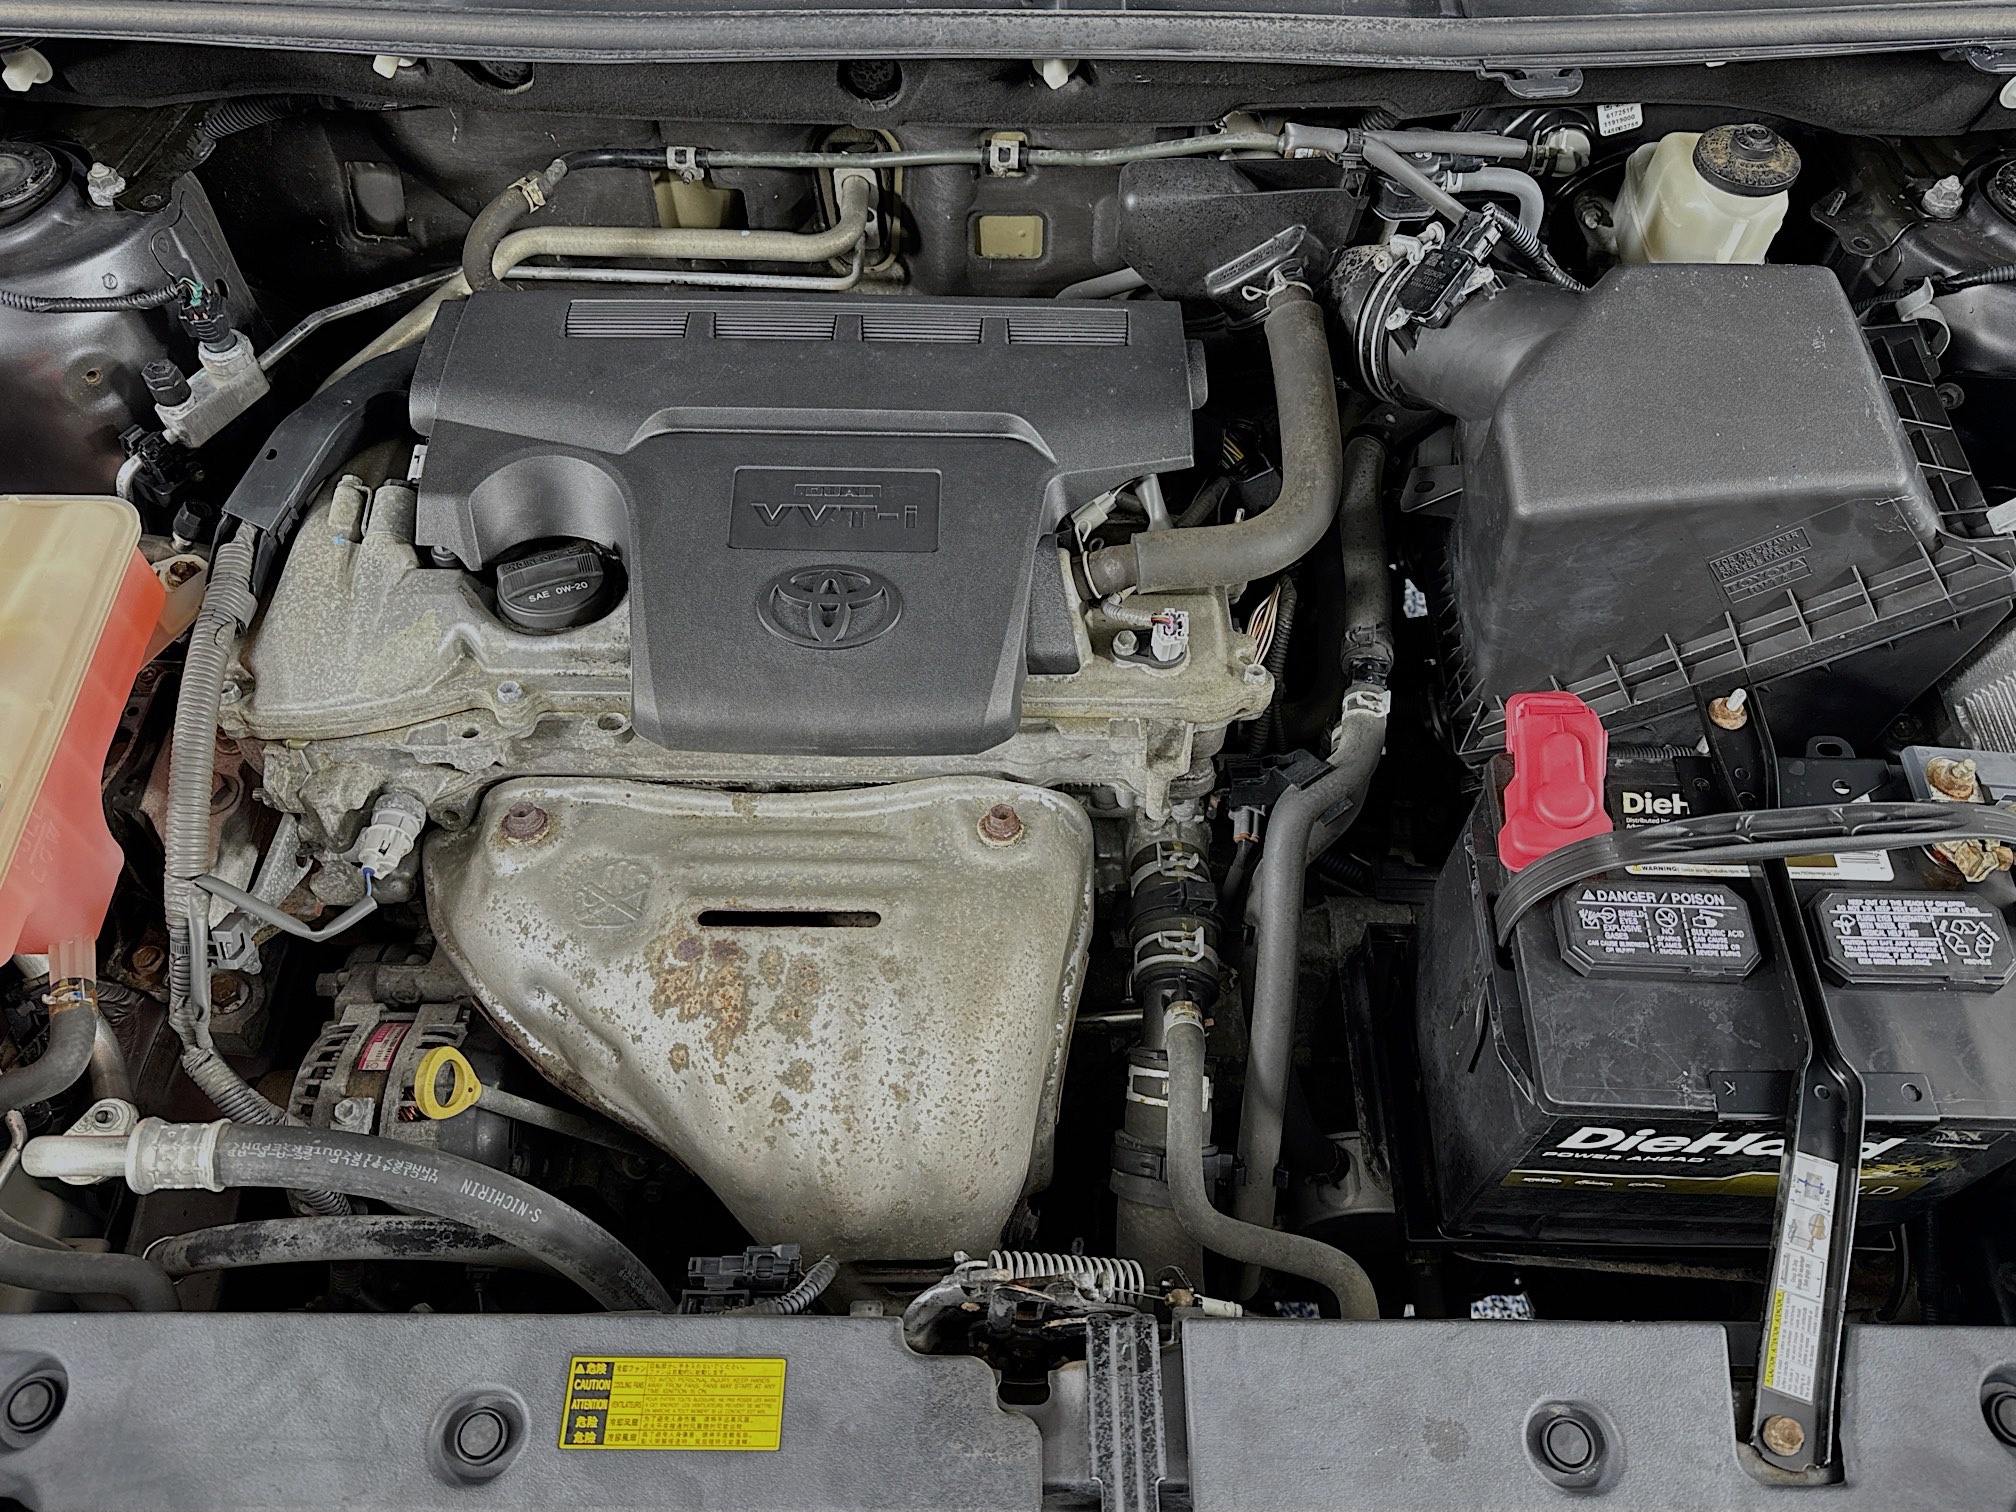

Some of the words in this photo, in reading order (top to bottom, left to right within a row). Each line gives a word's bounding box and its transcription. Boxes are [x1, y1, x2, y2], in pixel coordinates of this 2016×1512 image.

[804, 487, 874, 498] DUAL
[750, 503, 918, 529] VVT-i
[1714, 556, 1736, 567] FOR
[1737, 549, 1754, 559] AIR
[1724, 557, 1807, 592] TOYOTA
[528, 590, 551, 603] SAE
[555, 581, 588, 595] 0W-20
[1622, 792, 1690, 814] DieH
[1596, 890, 1656, 903] DANGER
[1671, 893, 1725, 906] POISON
[1618, 910, 1644, 918] SHIELD
[1603, 924, 1642, 932] EXPLOSIVE
[1691, 928, 1726, 937] SULFURIC
[1728, 930, 1744, 938] ACID
[1604, 932, 1629, 940] GASES
[1556, 1126, 1908, 1159] DieHad
[1542, 1151, 1623, 1161] POWER
[1626, 1155, 1705, 1163] AHEAD
[574, 1379, 611, 1390] CAUTION
[571, 1399, 608, 1410] ATTENTION
